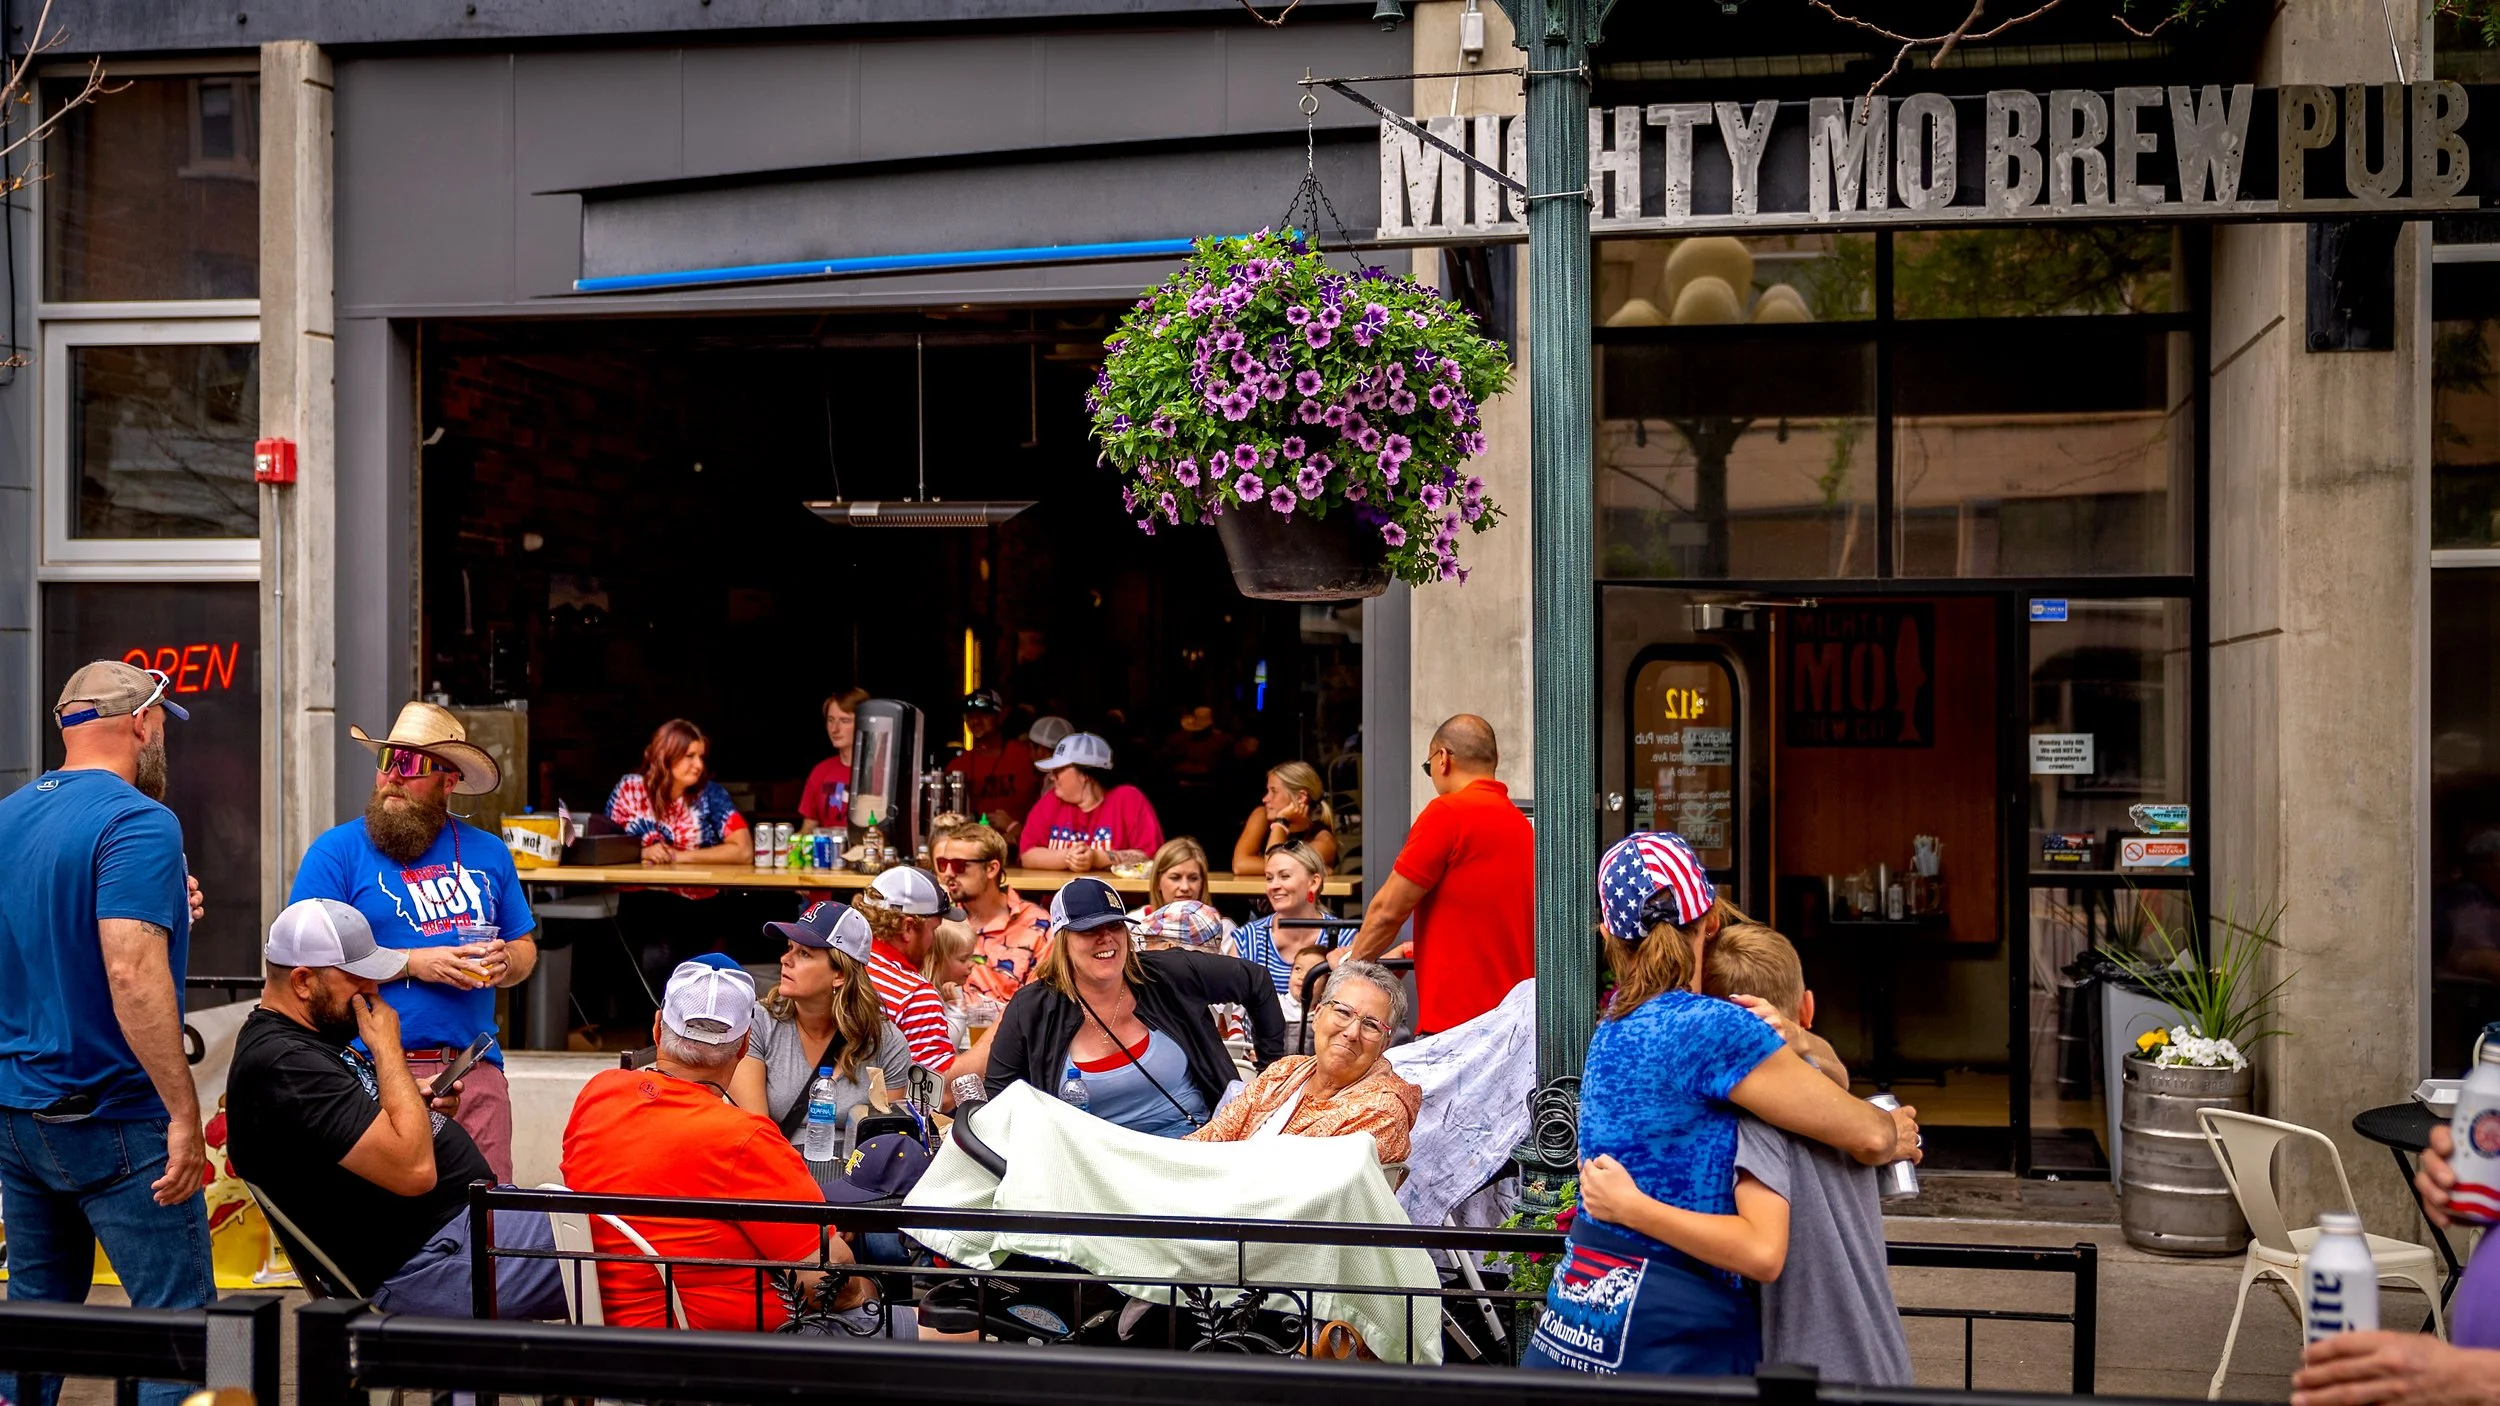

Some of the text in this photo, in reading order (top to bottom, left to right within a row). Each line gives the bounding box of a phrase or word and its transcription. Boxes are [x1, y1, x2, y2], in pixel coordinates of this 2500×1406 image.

[1809, 93, 1958, 213] MO
[1985, 83, 2254, 207] BREW
[2277, 80, 2471, 202] PUB
[1794, 641, 1886, 714] MO
[1687, 823, 1713, 834] GIFT
[406, 876, 468, 922] MO
[422, 919, 452, 937] BREW
[2309, 1271, 2343, 1345] ite
[1543, 1310, 1603, 1352] Columbia
[1561, 1356, 1588, 1371] SINCE
[1593, 1365, 1617, 1375] 19
